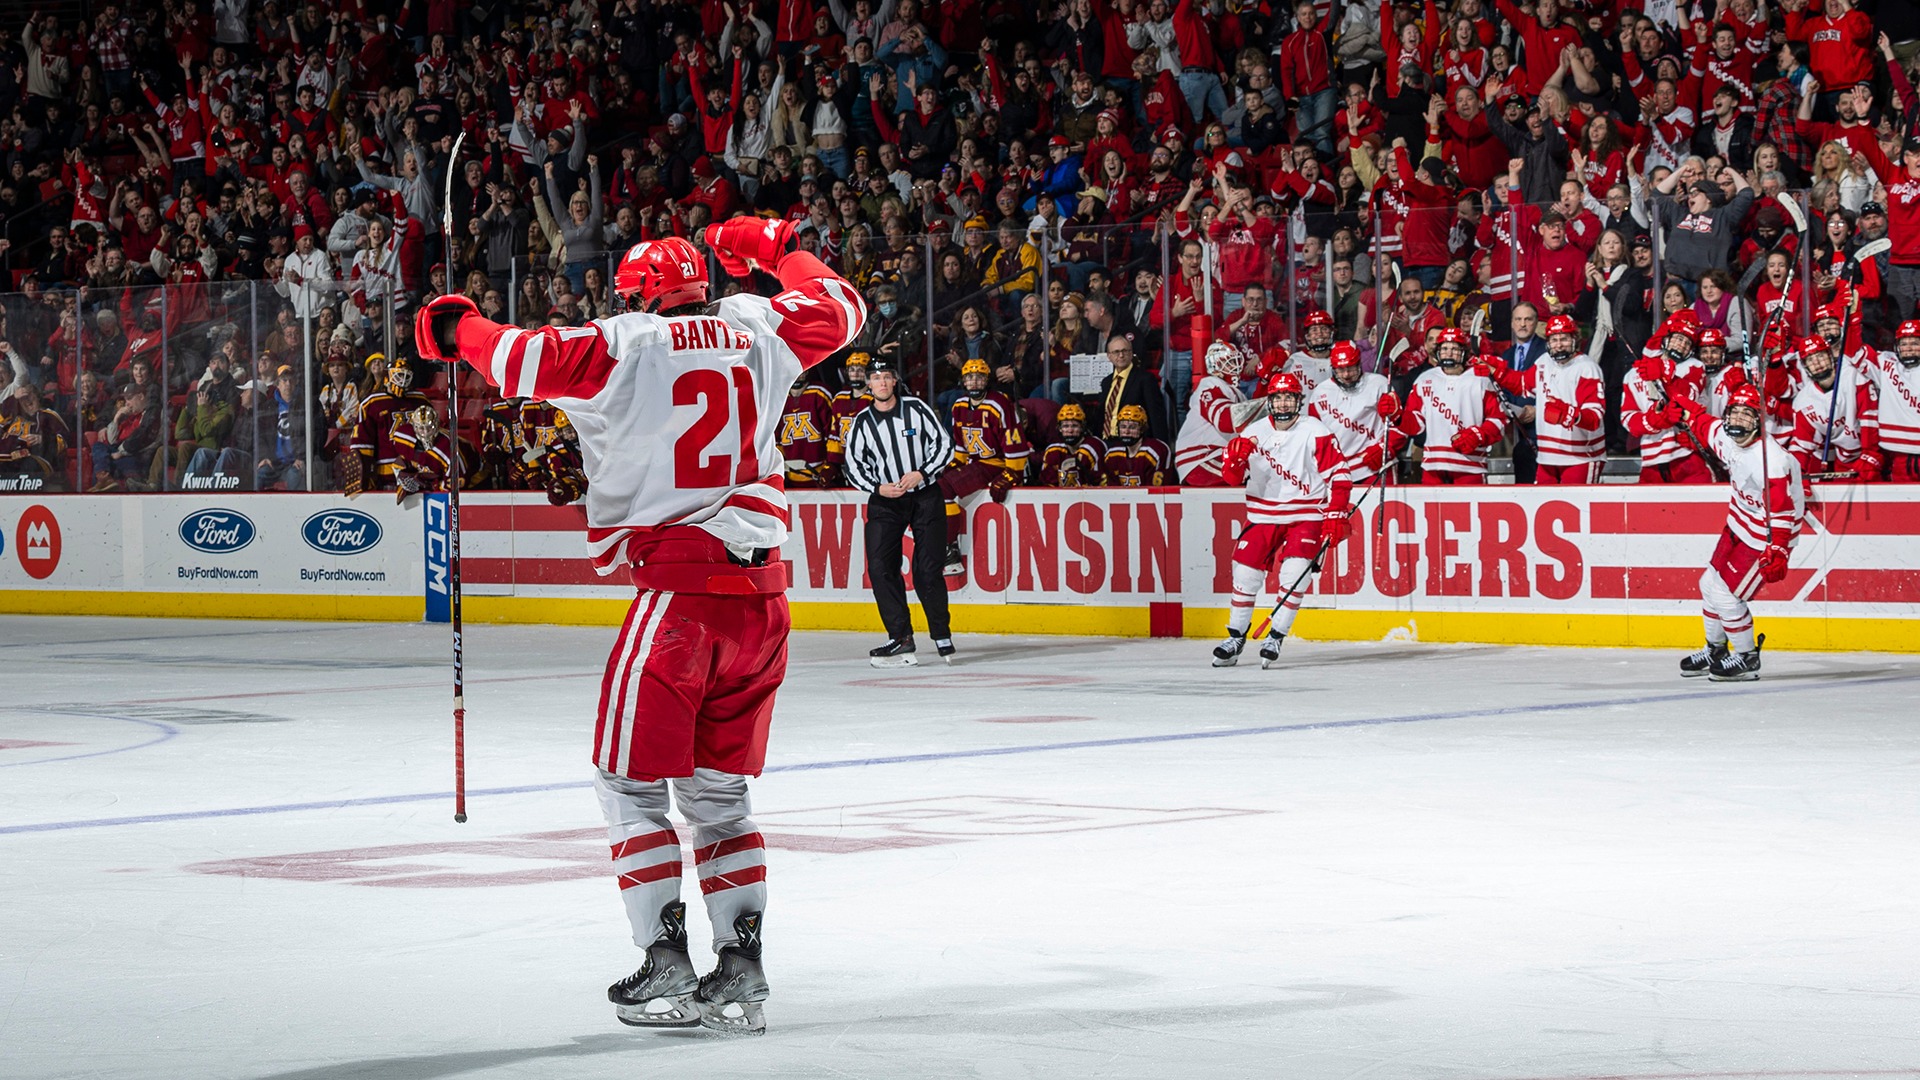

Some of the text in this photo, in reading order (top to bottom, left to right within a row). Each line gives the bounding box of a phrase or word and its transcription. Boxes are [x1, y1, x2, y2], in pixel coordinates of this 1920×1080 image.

[680, 262, 696, 277] 21
[1422, 386, 1464, 431] WISCONS
[1883, 360, 1920, 415] WISCONS
[673, 365, 759, 489] 21
[780, 411, 822, 445] M
[1004, 428, 1022, 445] 14
[1318, 400, 1375, 440] WISCONSIN
[194, 515, 241, 546] Ford
[317, 515, 367, 547] Ford
[427, 498, 447, 596] CCM
[451, 507, 459, 562] JETSPEED
[799, 502, 1183, 594] WONSIN
[1211, 499, 1584, 600] BDGERS
[178, 566, 259, 580] BuyFordNow.com
[300, 568, 386, 582] BuyFordNow.com
[454, 631, 462, 686] CCM
